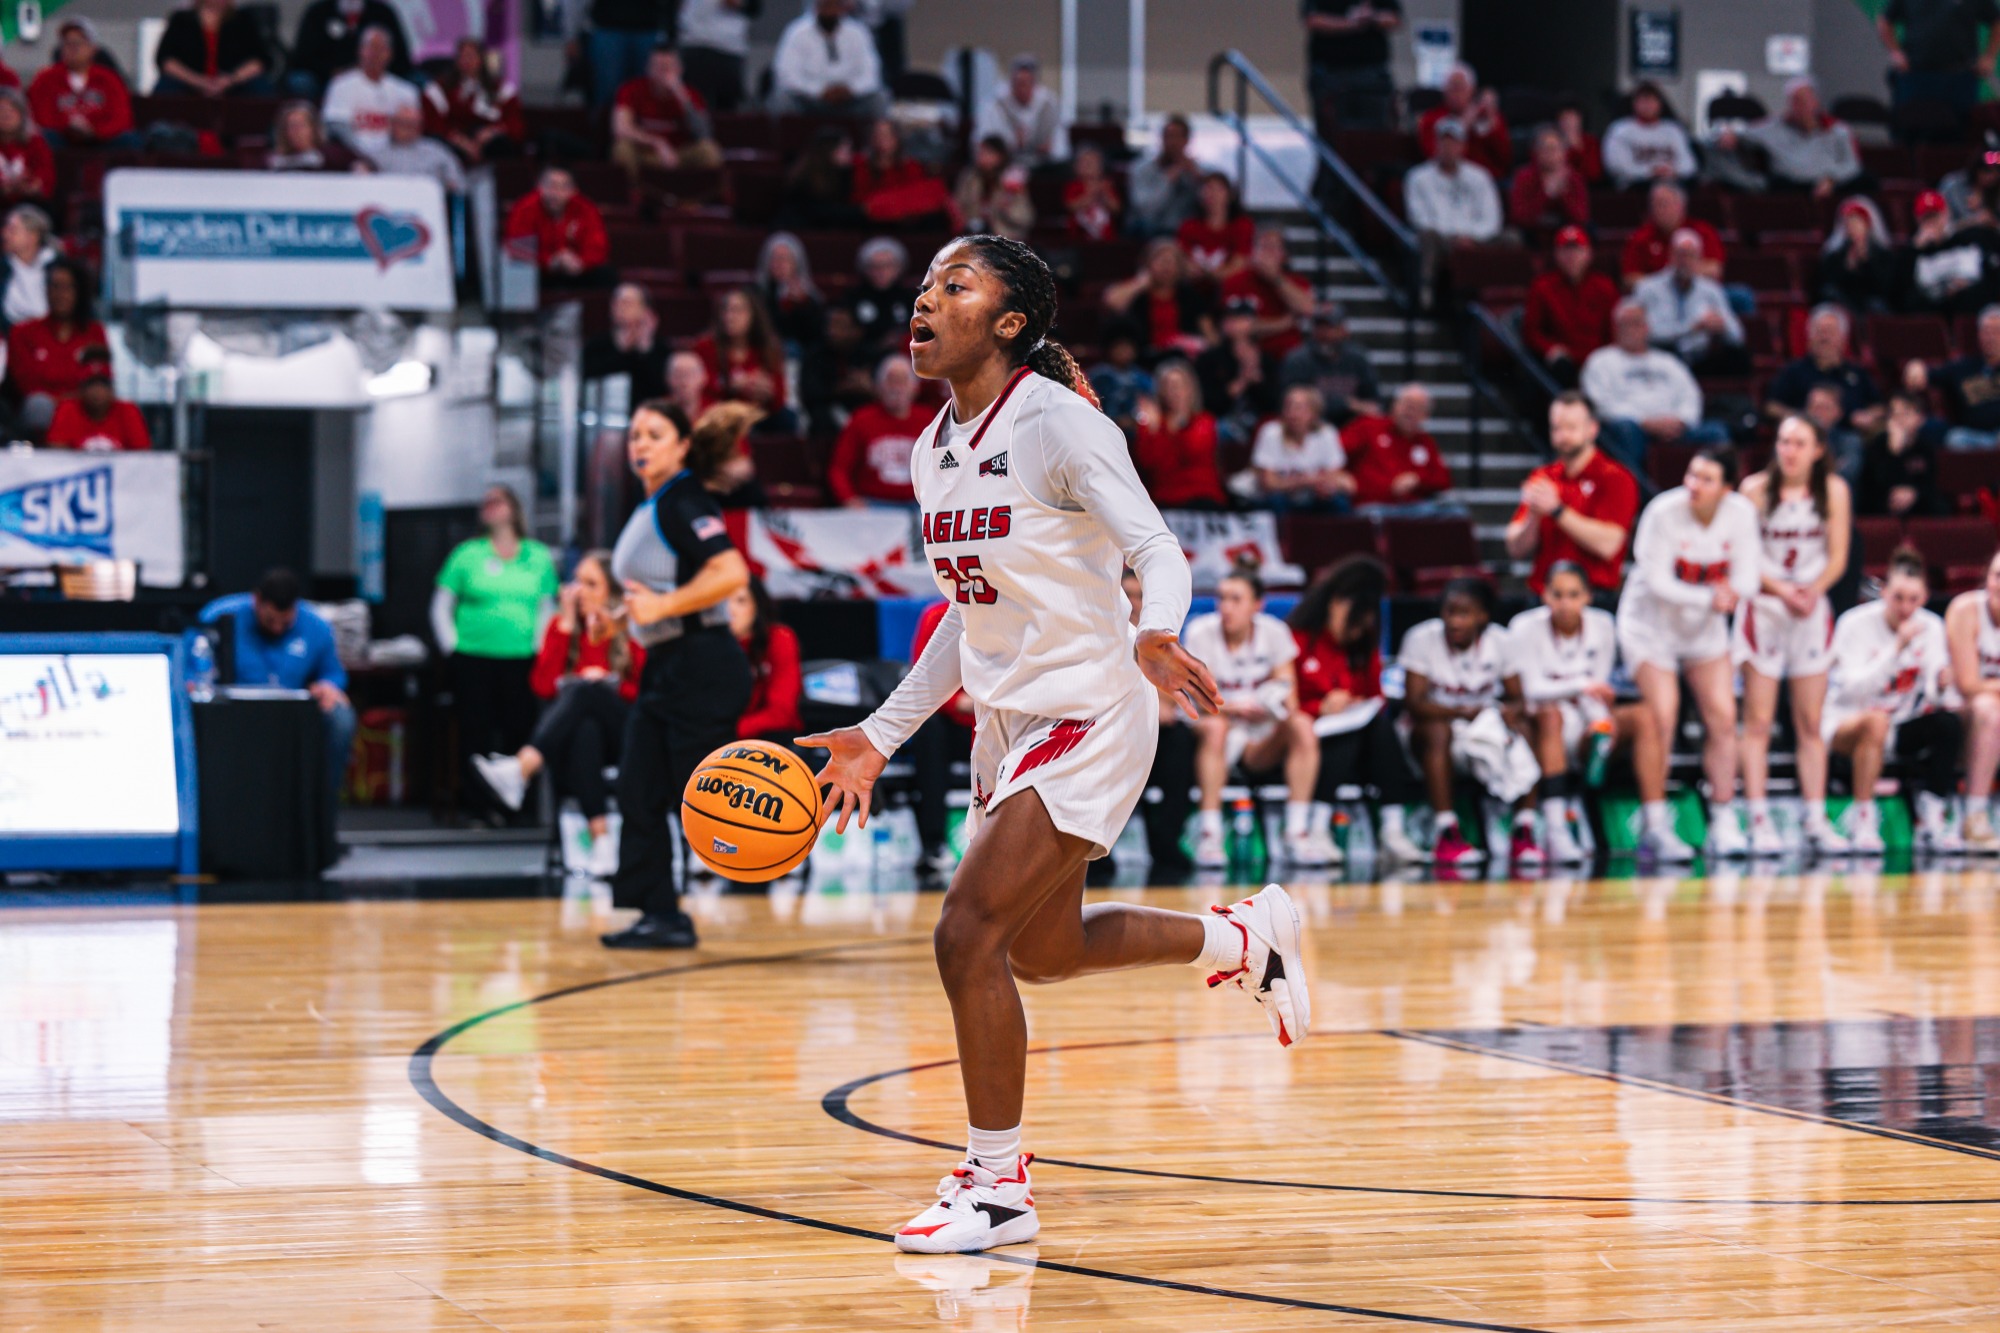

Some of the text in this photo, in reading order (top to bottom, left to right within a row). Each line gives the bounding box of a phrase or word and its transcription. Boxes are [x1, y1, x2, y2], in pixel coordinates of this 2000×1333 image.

[940, 461, 959, 470] adidas
[22, 471, 108, 535] SKY
[721, 747, 790, 775] NCAA
[696, 775, 784, 823] Wilson
